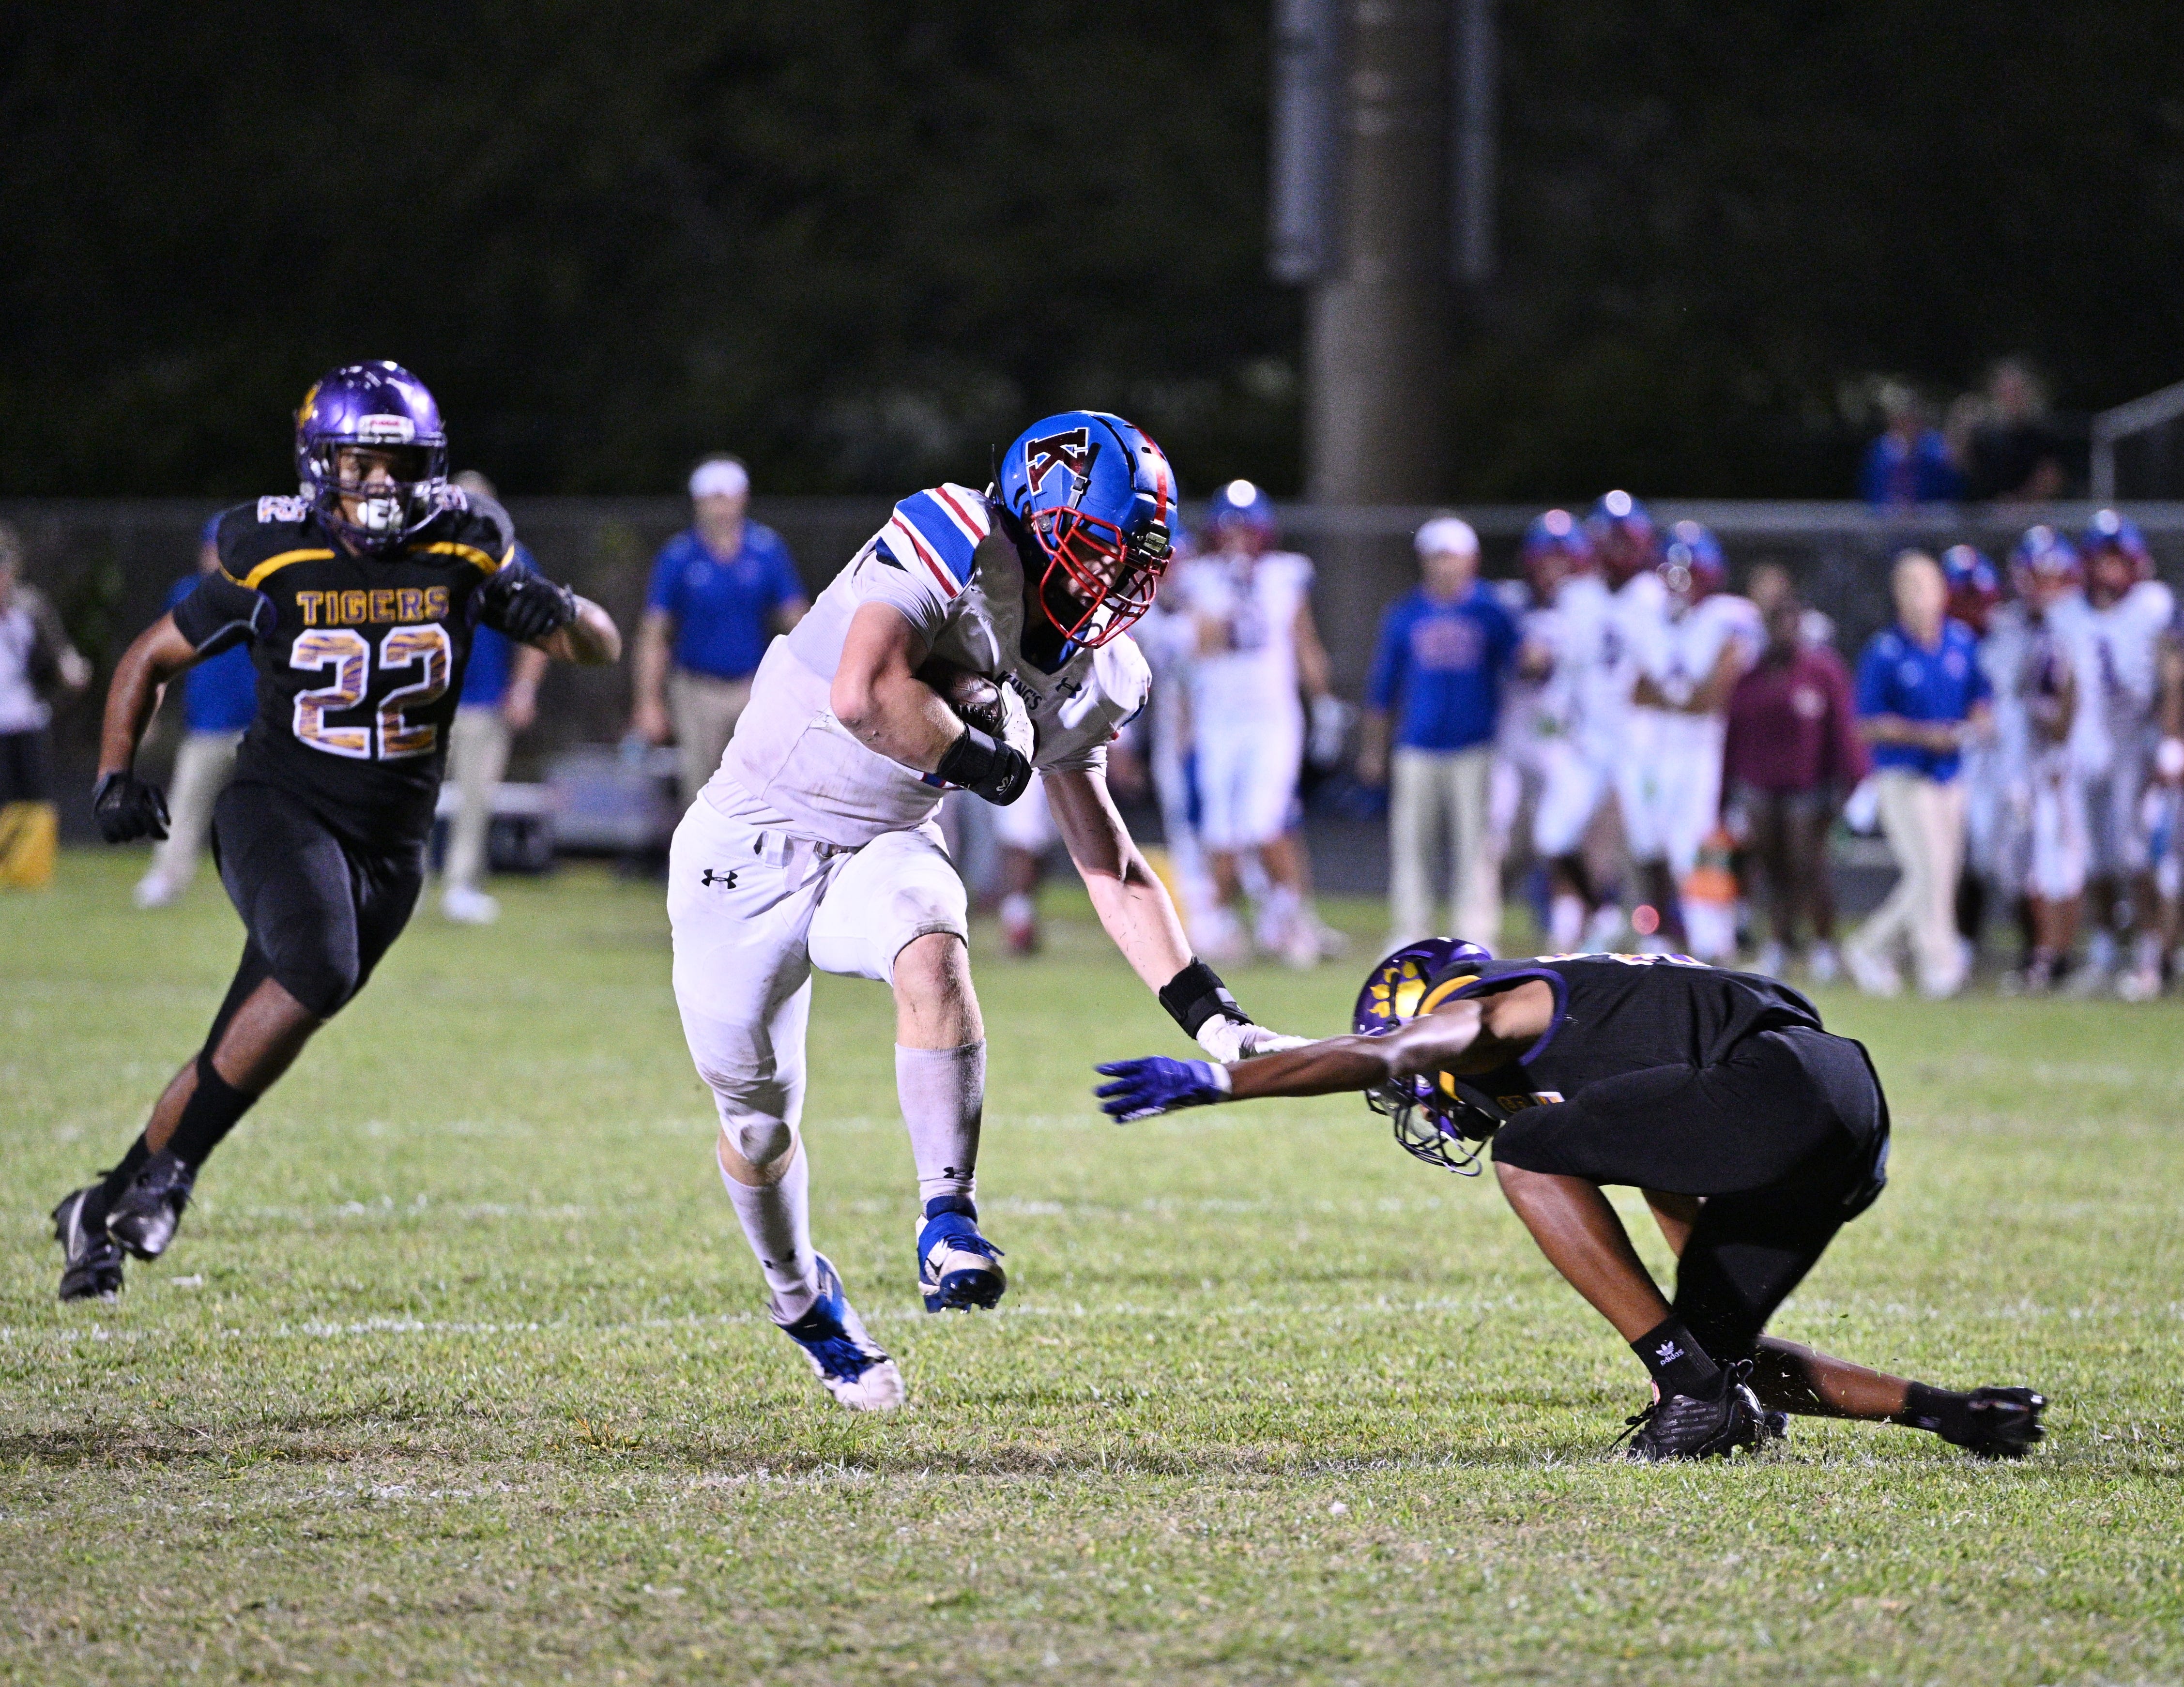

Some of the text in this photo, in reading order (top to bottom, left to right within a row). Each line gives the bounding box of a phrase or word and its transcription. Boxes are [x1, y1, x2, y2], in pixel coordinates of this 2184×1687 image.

[1025, 427, 1089, 495] K
[296, 586, 449, 625] TIGERS
[290, 623, 452, 761] 22
[1660, 1349, 1684, 1366] adidas
